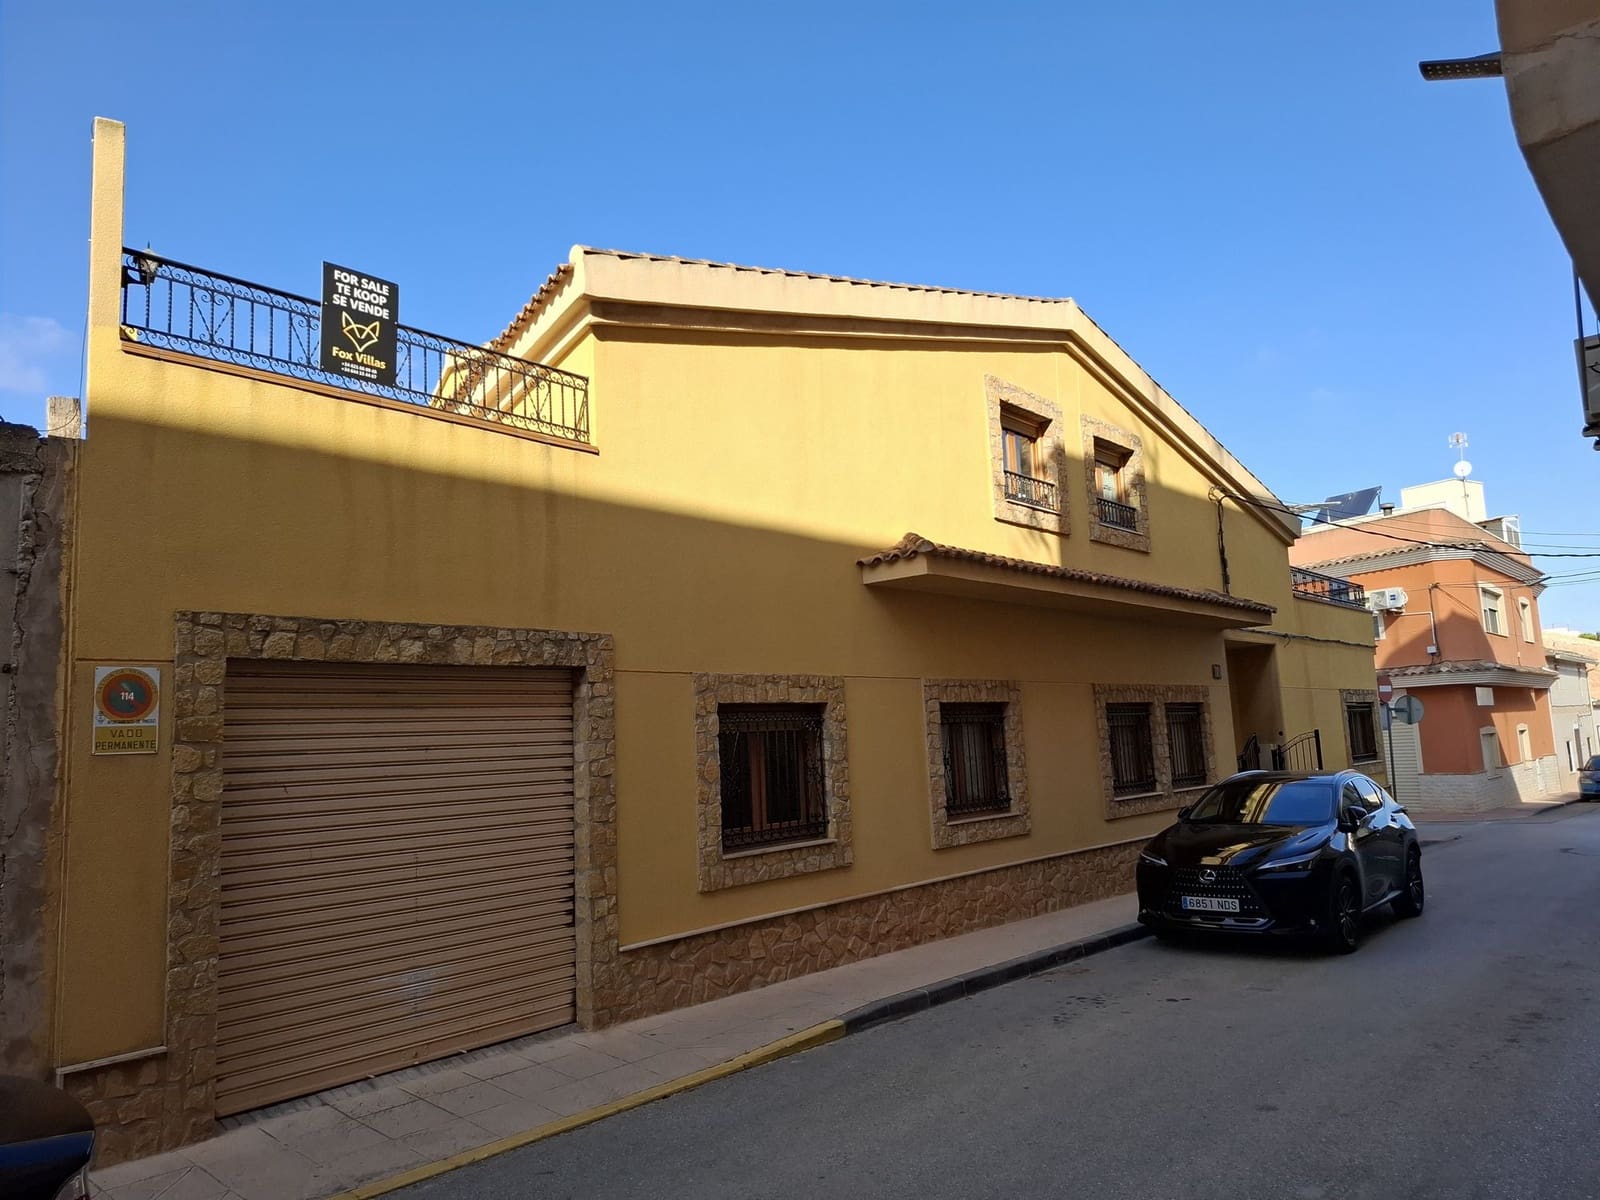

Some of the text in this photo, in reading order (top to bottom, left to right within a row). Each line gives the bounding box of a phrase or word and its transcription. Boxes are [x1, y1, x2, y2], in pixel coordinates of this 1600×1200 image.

[334, 269, 390, 296] FOR SALE
[335, 282, 387, 306] TE KOOP
[332, 294, 390, 320] SE VENDE
[332, 346, 353, 361] Fox
[355, 351, 387, 370] Villas
[120, 691, 135, 701] 114
[110, 728, 143, 738] VADO
[95, 740, 157, 751] PERMANENTE
[1188, 898, 1238, 911] 6851 NDS
